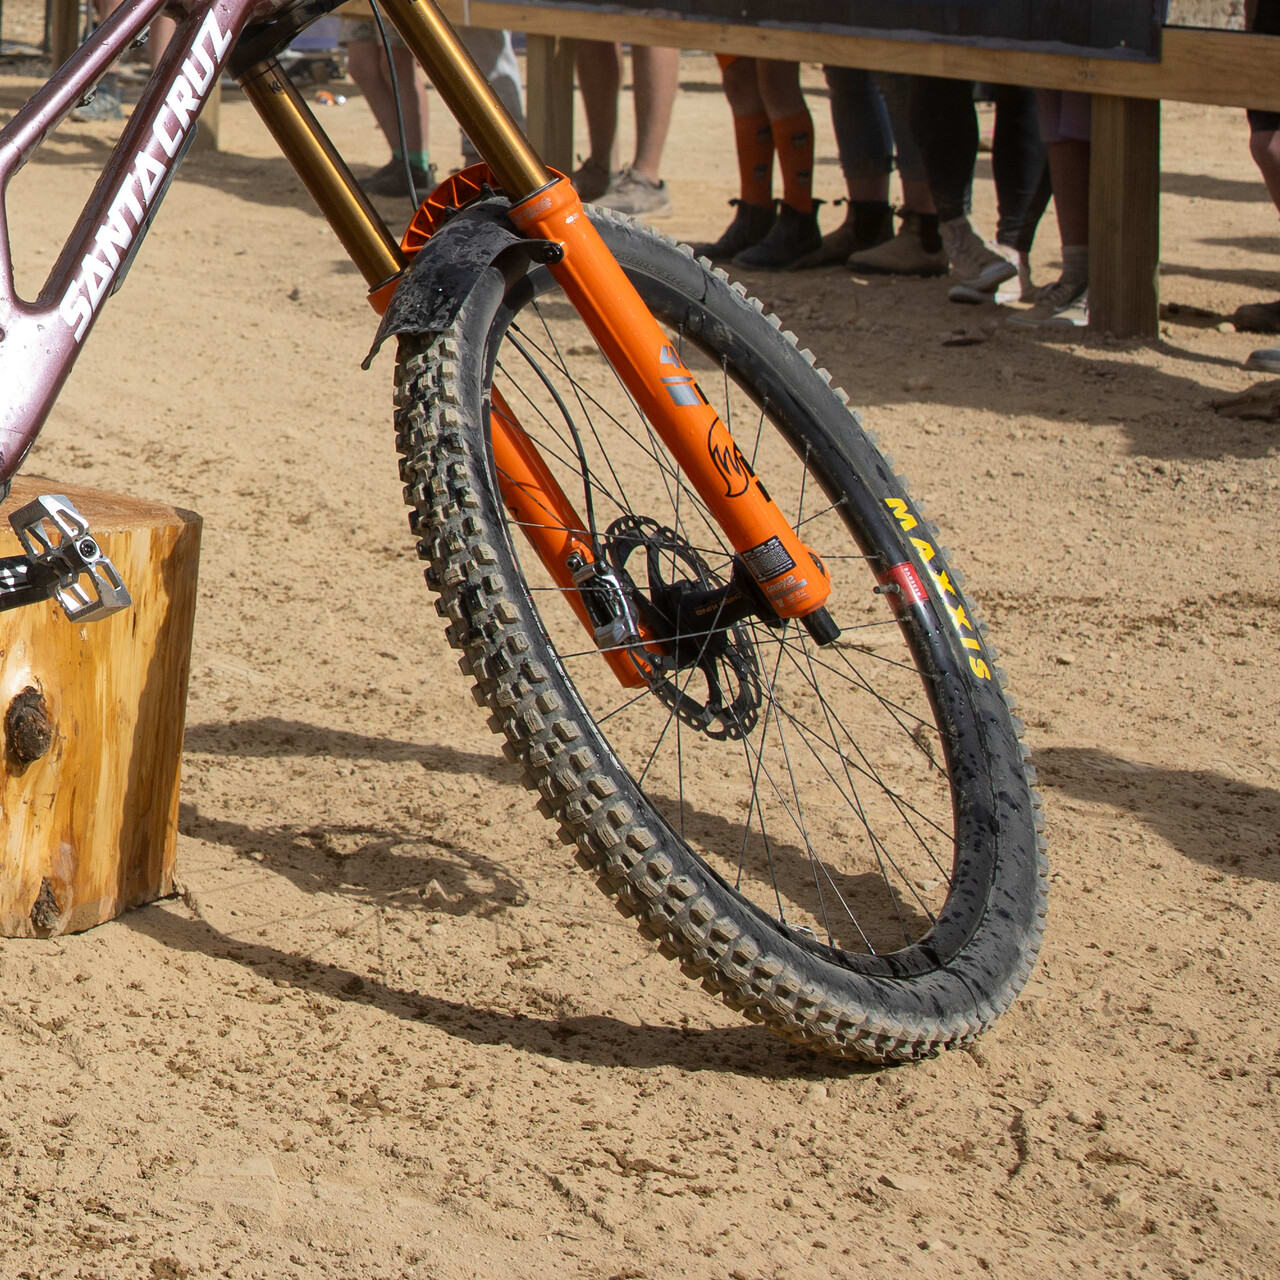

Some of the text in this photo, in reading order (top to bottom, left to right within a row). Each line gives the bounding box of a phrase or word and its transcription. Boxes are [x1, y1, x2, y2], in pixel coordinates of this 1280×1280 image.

[56, 7, 233, 344] SANTA CRUZ
[884, 497, 992, 681] MAXXIS
